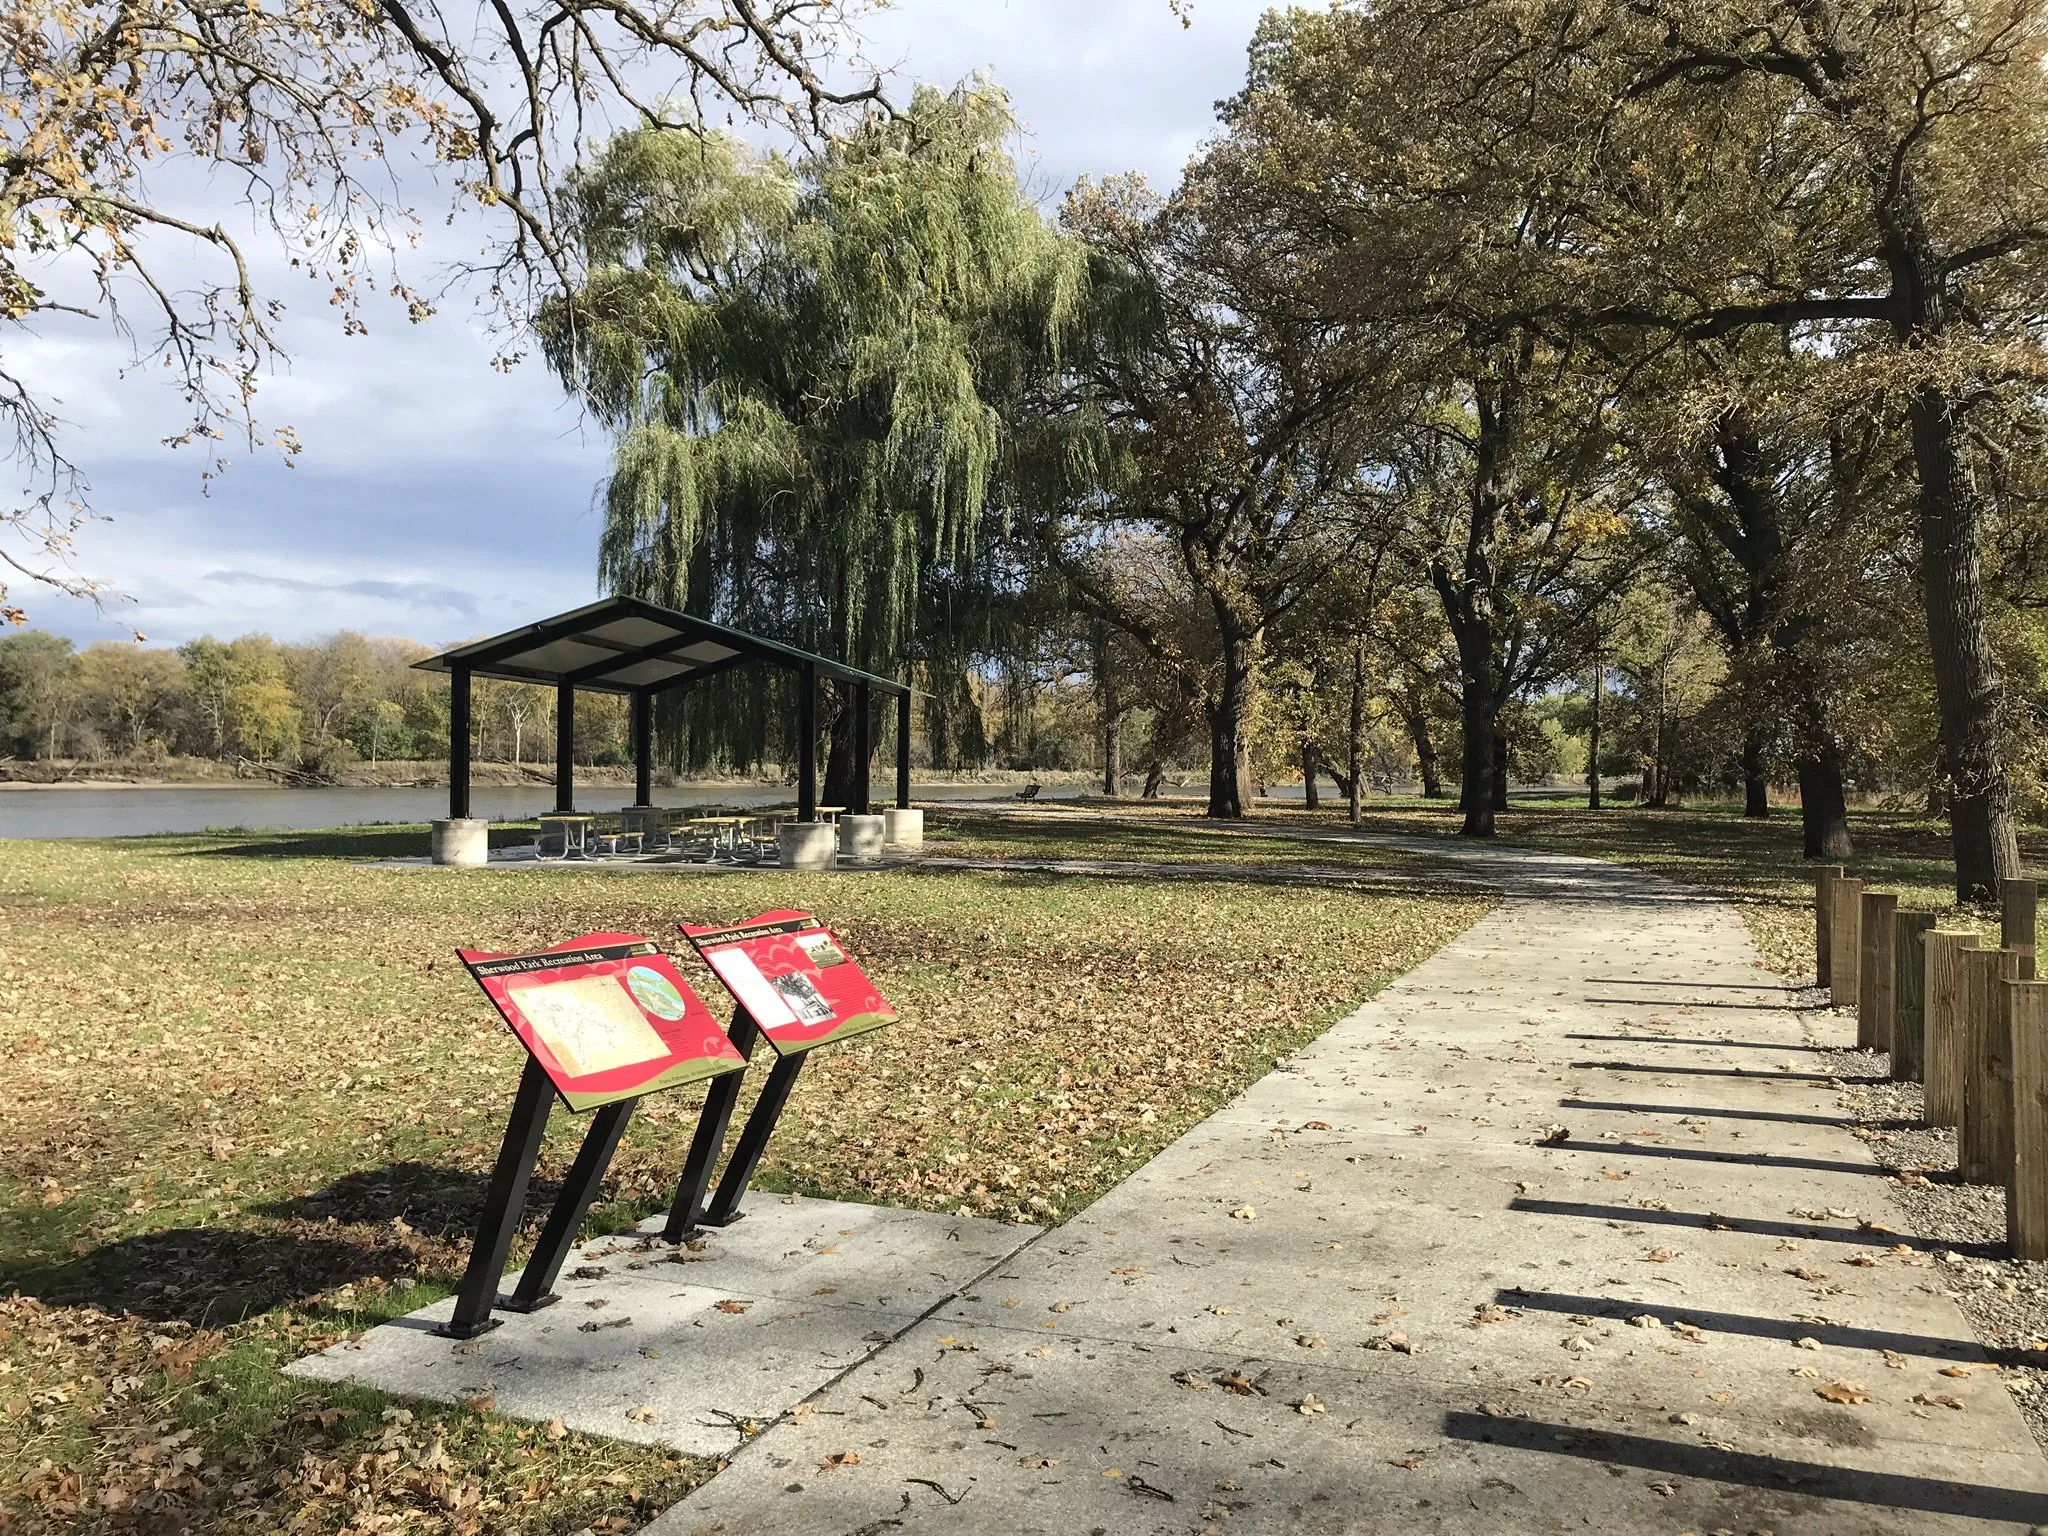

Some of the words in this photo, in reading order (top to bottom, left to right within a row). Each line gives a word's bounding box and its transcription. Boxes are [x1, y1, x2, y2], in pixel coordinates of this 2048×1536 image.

[476, 961, 521, 975] Sherwood
[521, 959, 542, 970] Park
[542, 954, 584, 967] Recreation
[584, 952, 604, 962] Area
